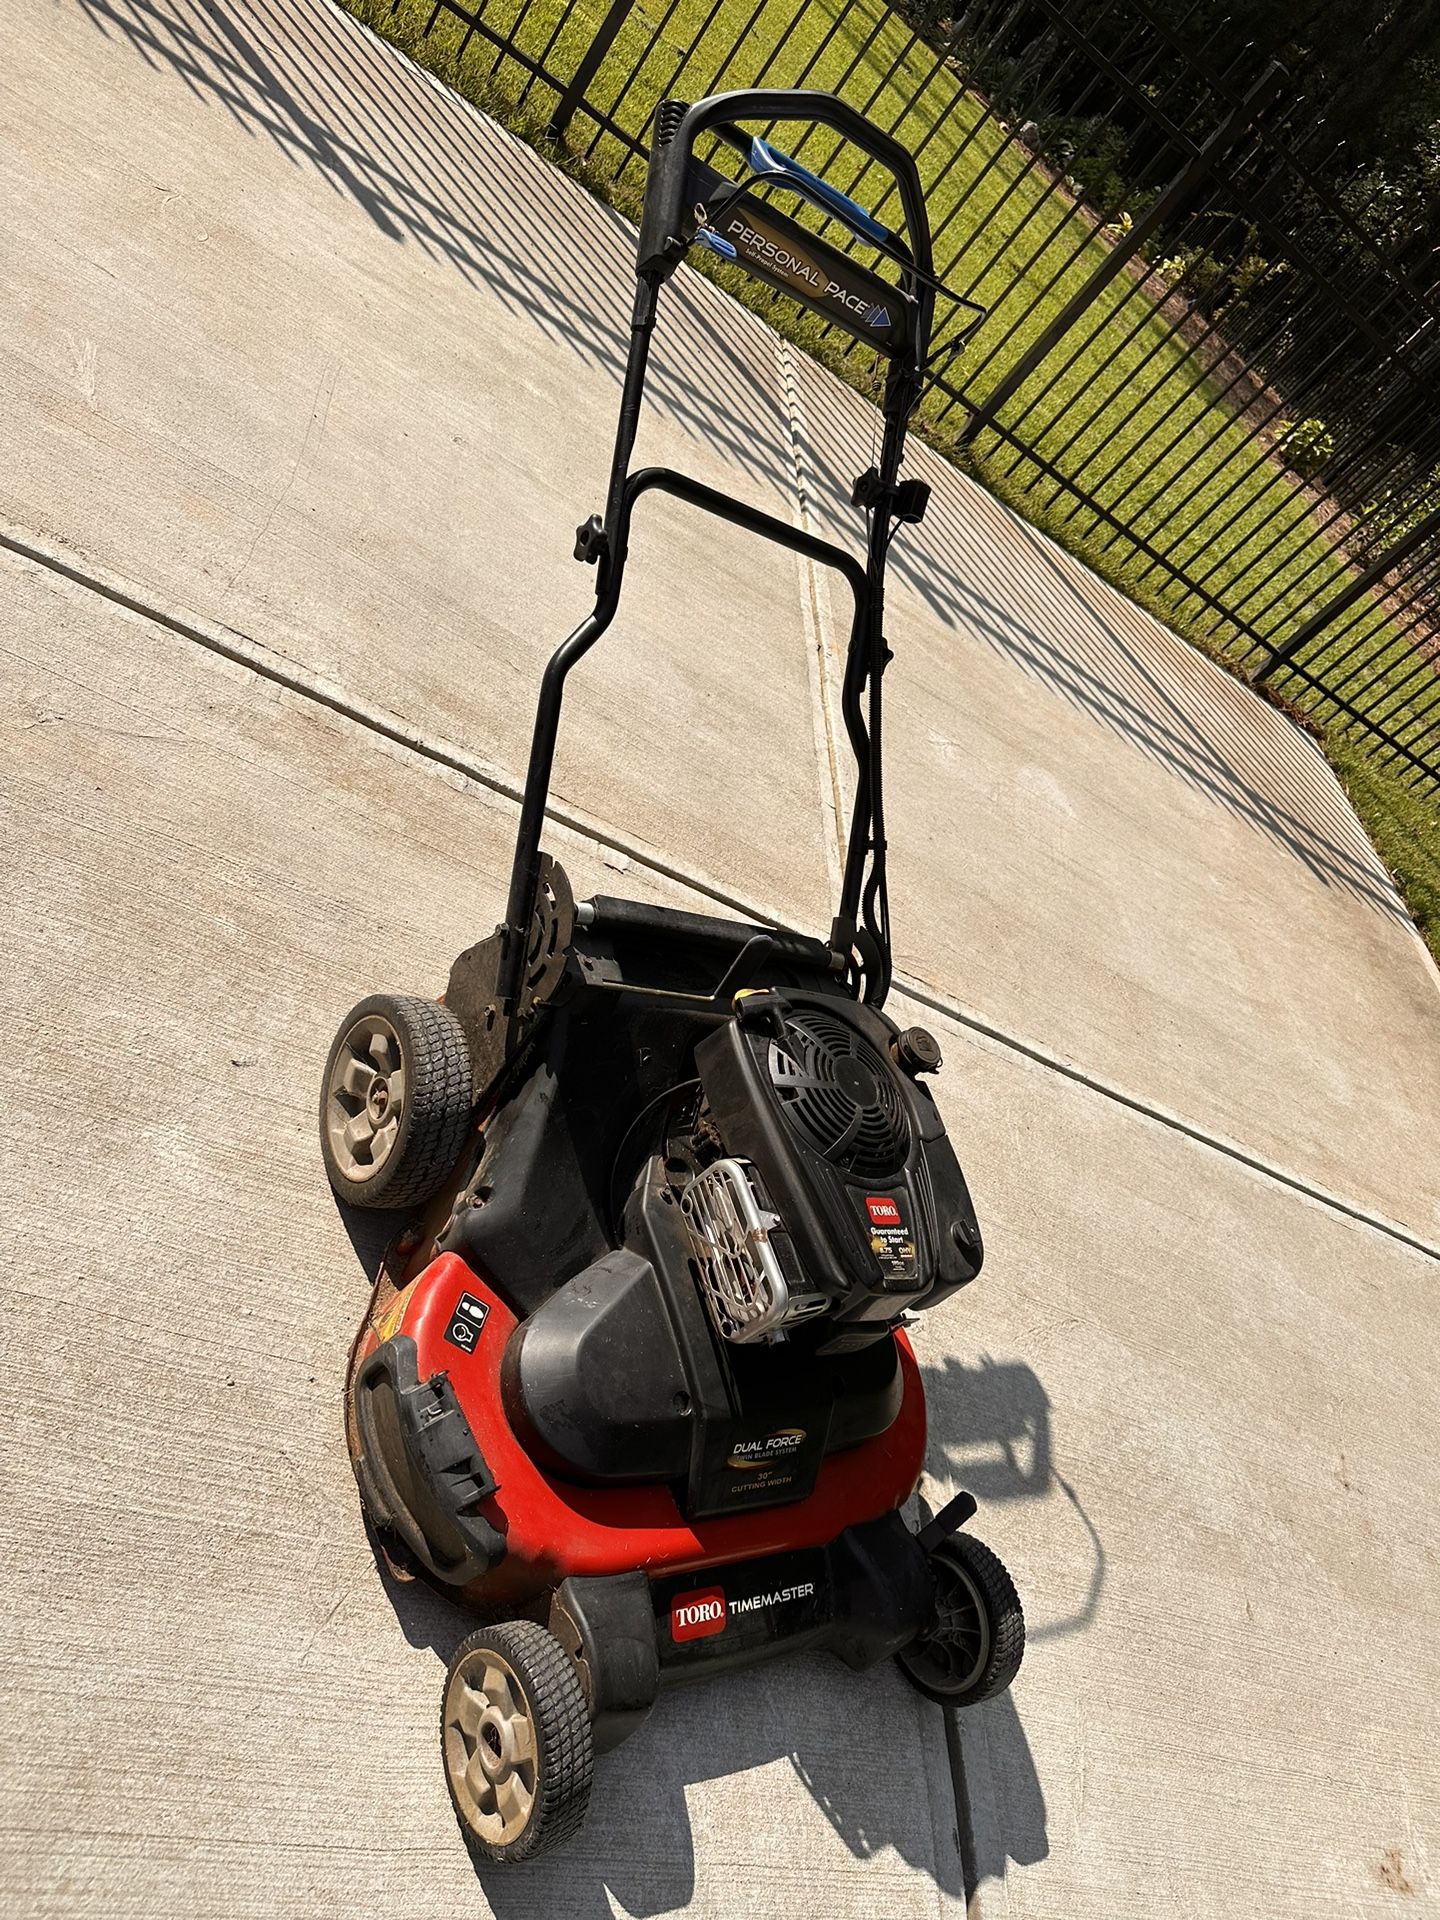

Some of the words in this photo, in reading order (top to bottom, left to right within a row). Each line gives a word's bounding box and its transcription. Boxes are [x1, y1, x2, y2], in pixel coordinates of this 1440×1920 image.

[727, 219, 819, 287] PERSONAL
[824, 281, 868, 315] PACE
[771, 262, 789, 278] System
[870, 1226, 909, 1236] Guaranteed
[887, 1235, 904, 1243] Start
[733, 1441, 763, 1454] DUAL
[765, 1434, 803, 1449] FORCE
[754, 1450, 774, 1459] BLADE
[775, 1446, 797, 1456] SYSTEM
[731, 1482, 766, 1493] CUTTING
[767, 1476, 792, 1487] WIDTH
[728, 1582, 815, 1615] TIMEMASTER
